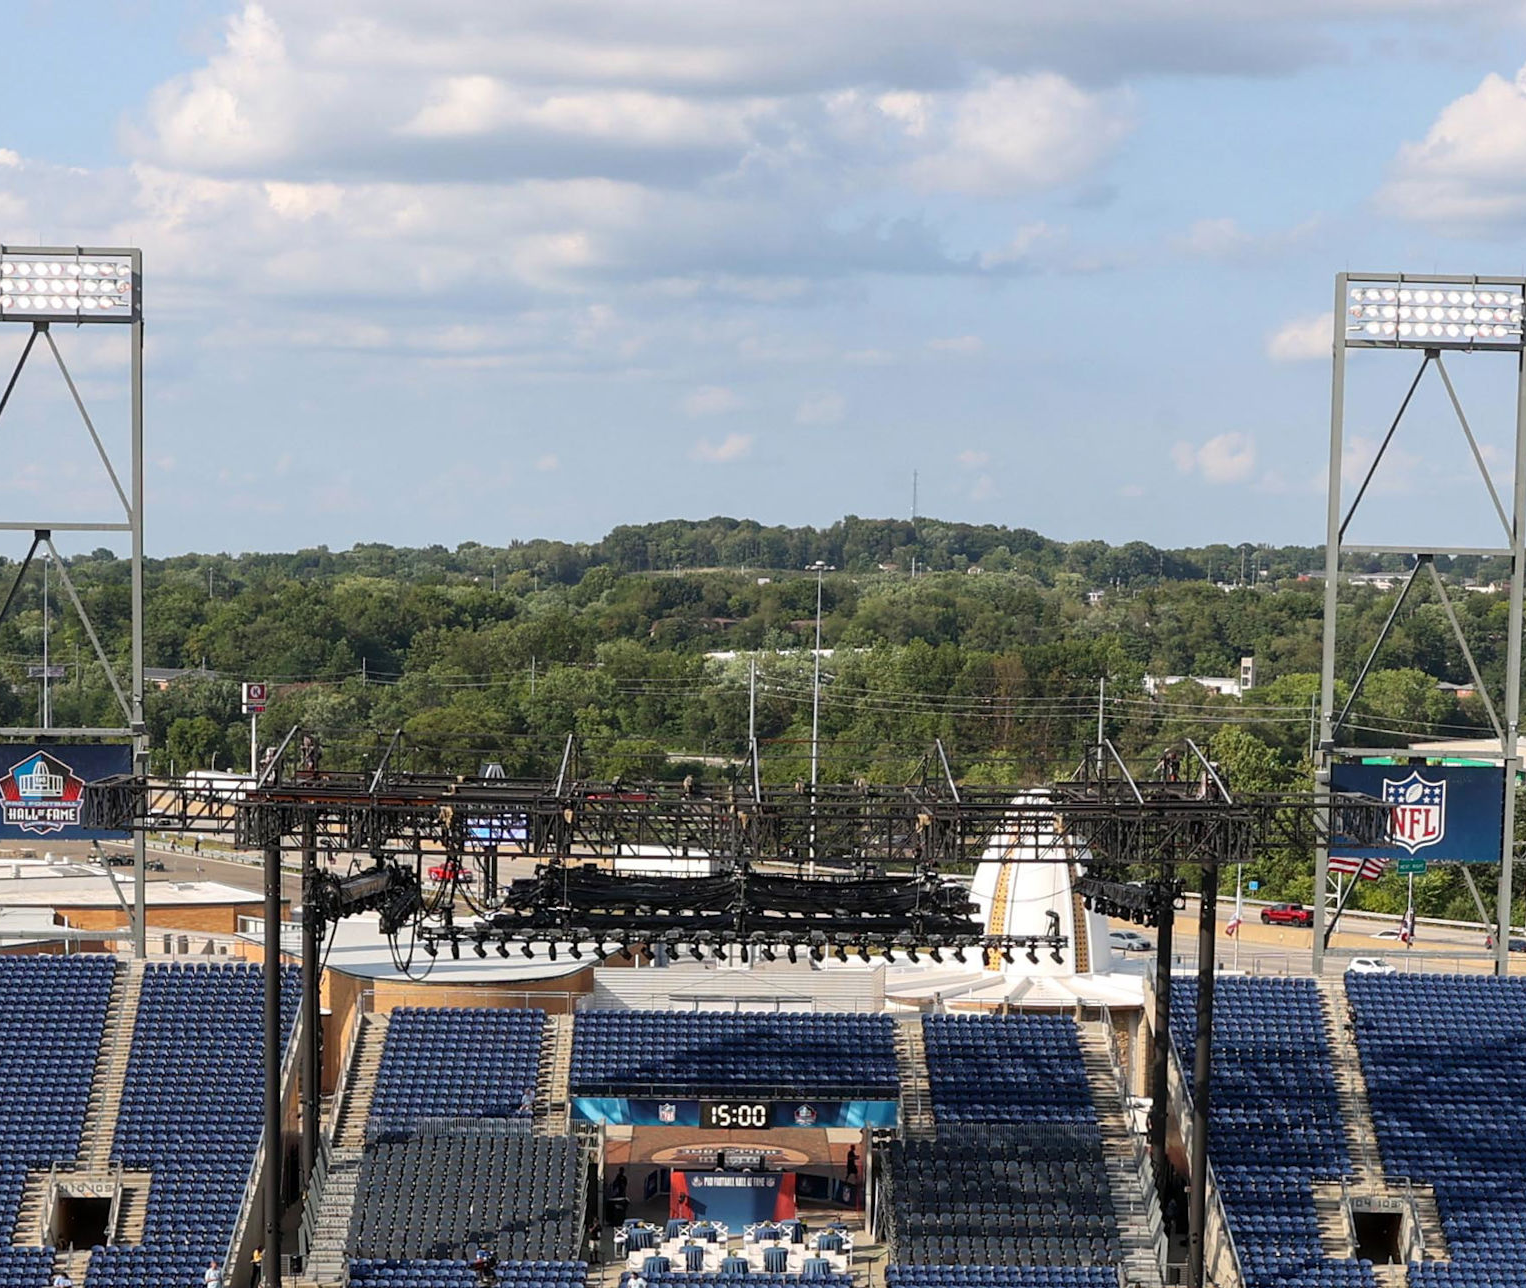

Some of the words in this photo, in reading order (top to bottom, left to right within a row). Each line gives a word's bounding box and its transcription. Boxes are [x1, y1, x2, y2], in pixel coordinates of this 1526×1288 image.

[8, 808, 38, 821] HALL
[46, 808, 75, 821] FAME
[1391, 807, 1436, 841] NFL
[711, 1104, 766, 1127] 15:00
